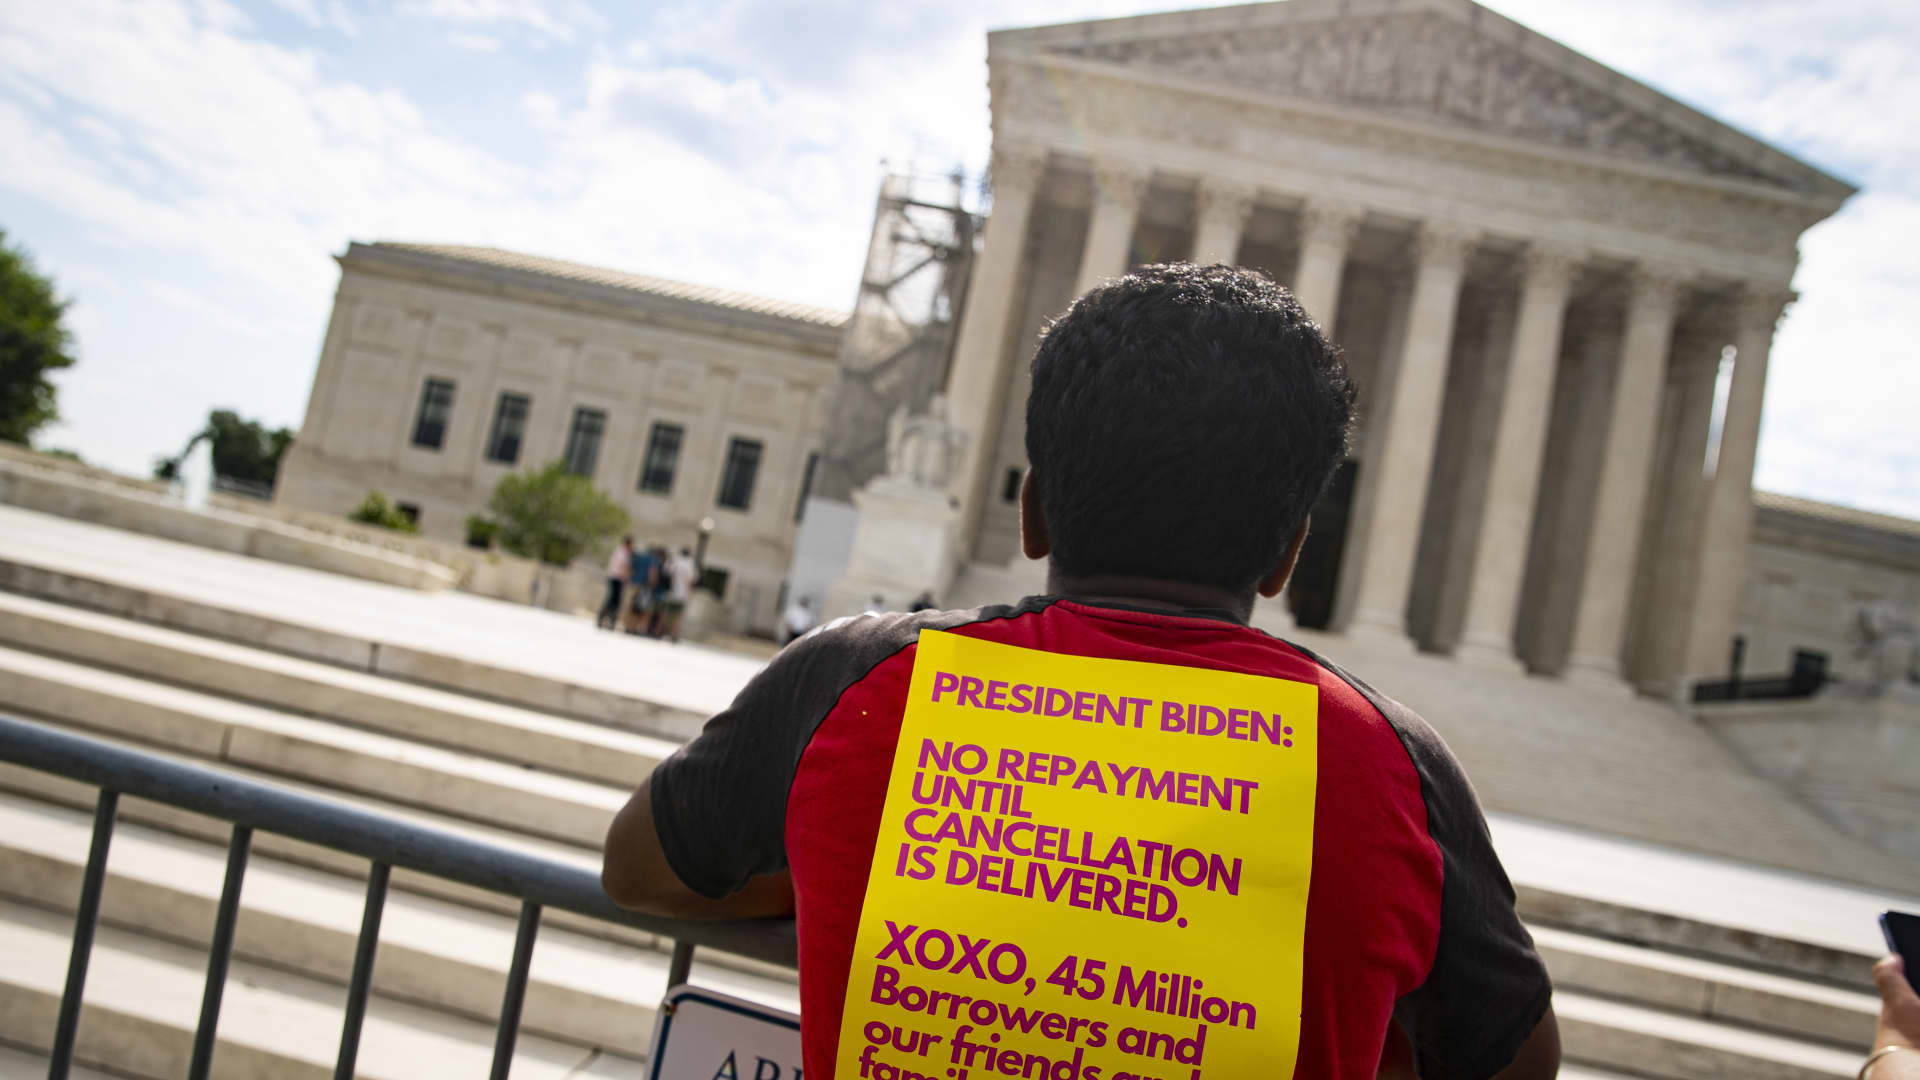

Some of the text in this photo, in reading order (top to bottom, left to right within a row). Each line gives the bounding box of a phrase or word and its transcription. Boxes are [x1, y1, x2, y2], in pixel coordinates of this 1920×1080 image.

[931, 671, 1294, 748] PRESIDENT BIDEN:
[911, 771, 1032, 819] UNTIL
[918, 738, 1259, 815] NO REPAYMENT
[895, 843, 1188, 929] IS DELIVERED.
[904, 807, 1242, 896] CANCELLATION
[870, 965, 1207, 1066] Borrowers and
[876, 920, 1257, 1030] XOXO, 45 Million
[863, 1021, 943, 1057] our
